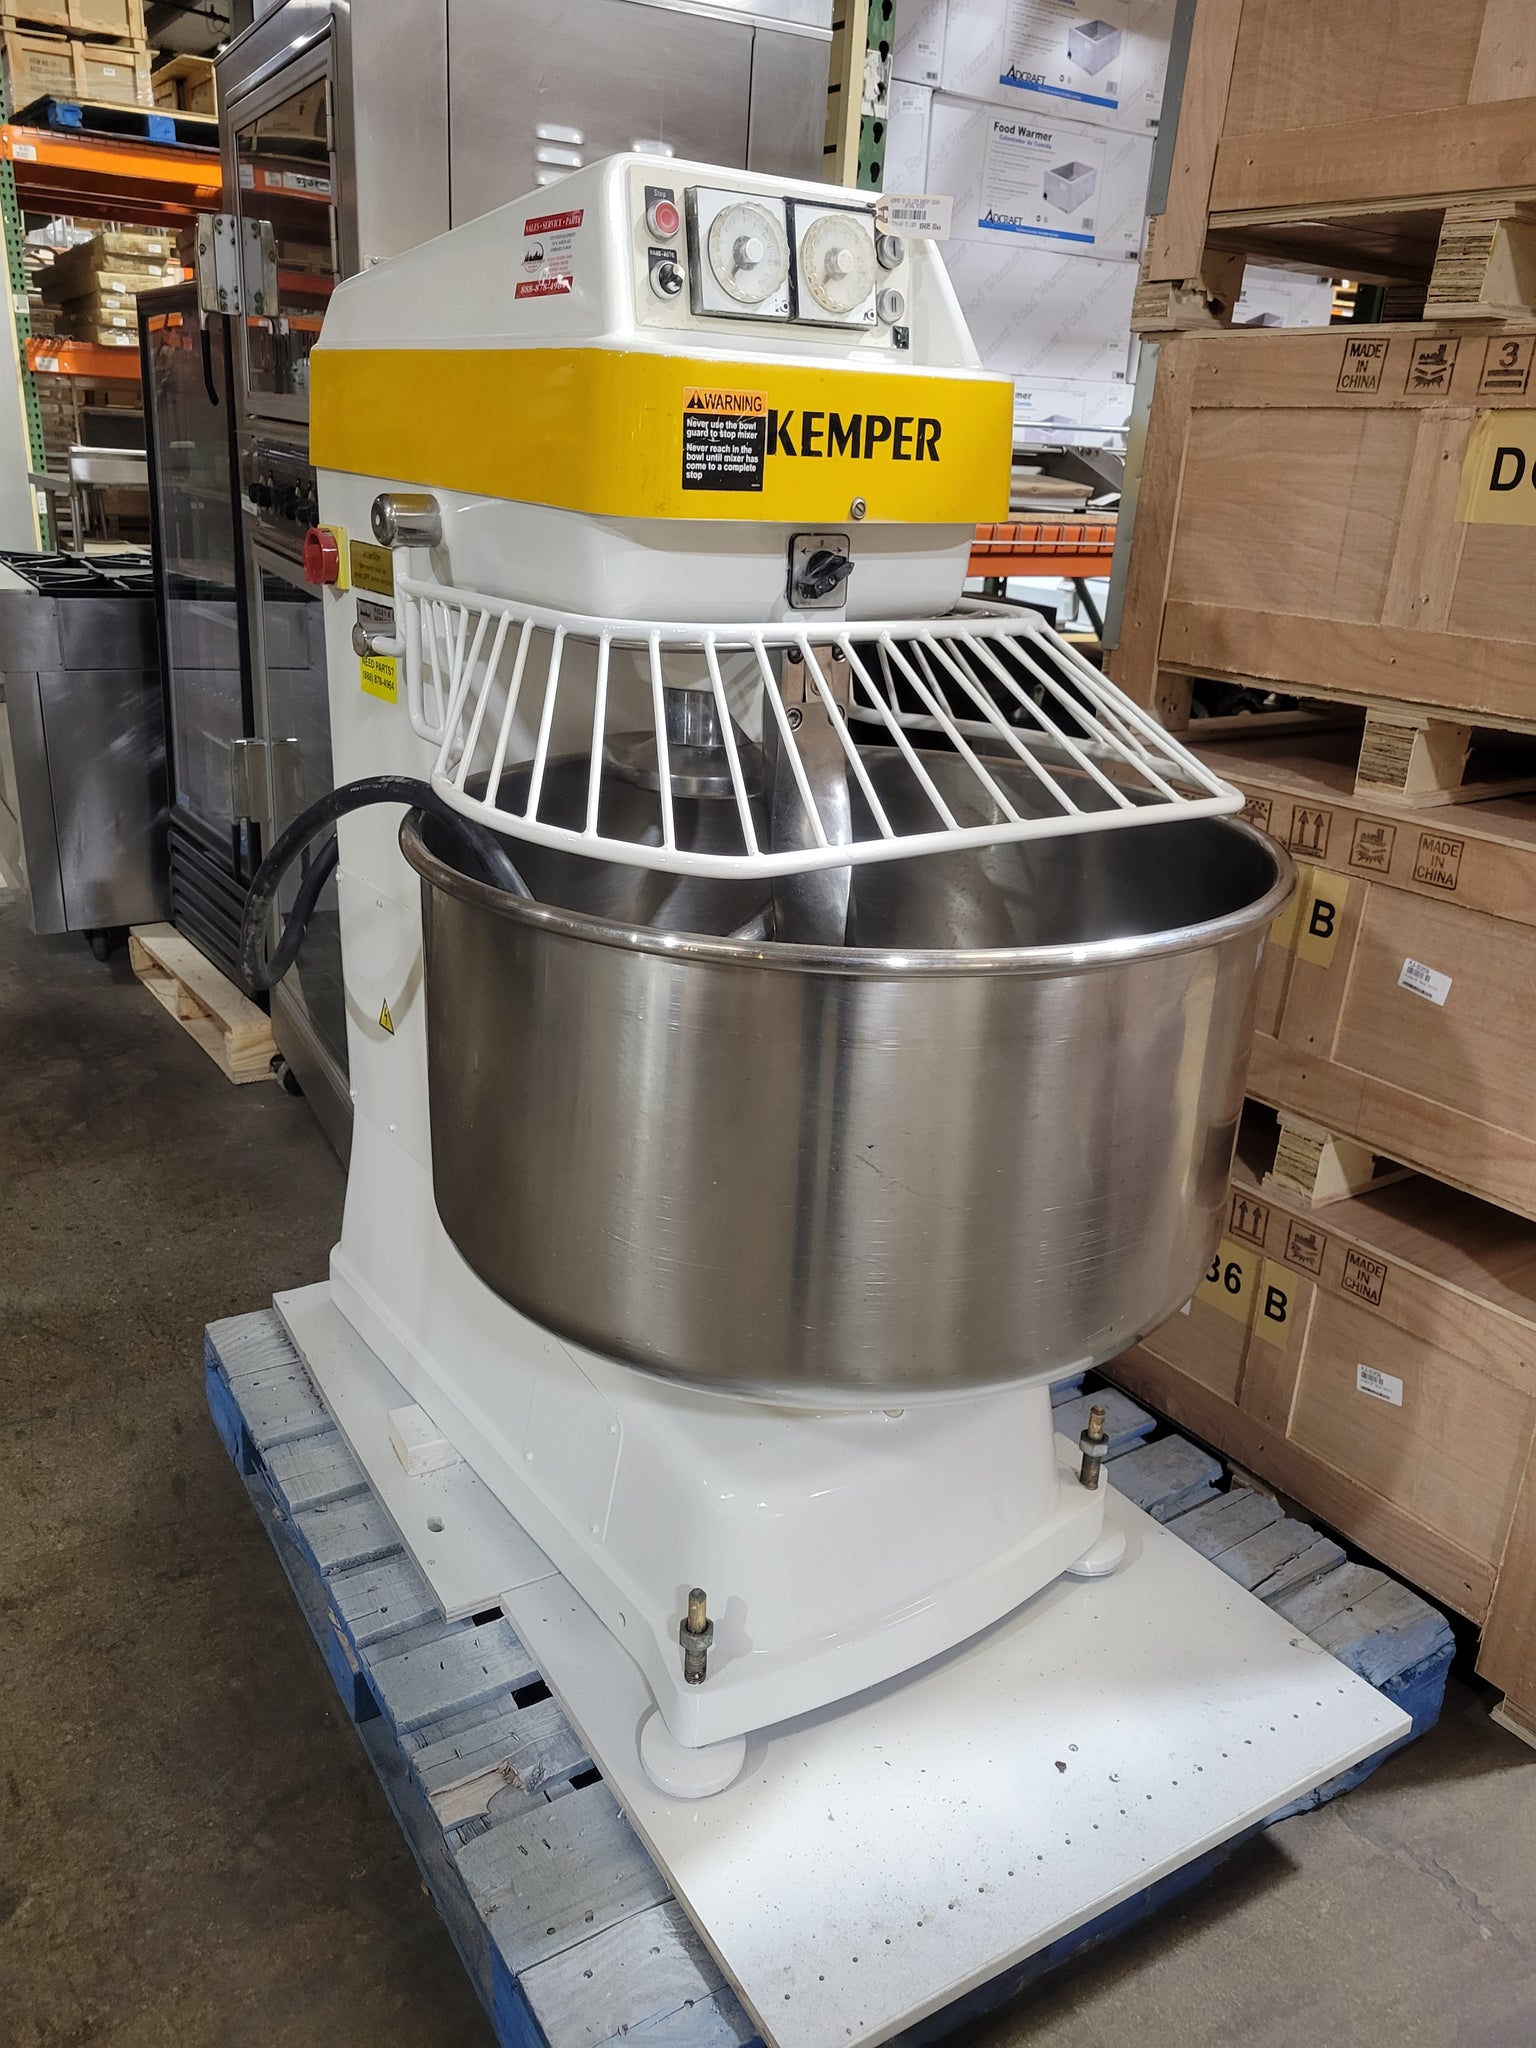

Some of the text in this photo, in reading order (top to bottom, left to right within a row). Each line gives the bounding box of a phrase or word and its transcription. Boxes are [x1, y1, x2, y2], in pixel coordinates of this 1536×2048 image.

[1006, 63, 1047, 85] ADCRAFT
[993, 121, 1052, 141] Food Warmer
[653, 189, 667, 199] Stop
[984, 208, 1024, 226] ADCRAFT
[1349, 343, 1384, 358] MADE
[1498, 341, 1520, 368] 3
[1355, 359, 1369, 373] IN
[1341, 374, 1376, 388] CHINA
[704, 393, 762, 412] WARNING
[1015, 392, 1032, 400] mer
[686, 418, 757, 430] Never use the bowl
[686, 428, 758, 440] guard to stop mixer
[766, 408, 942, 462] KEMPER
[686, 443, 753, 454] Never reach in the
[686, 452, 759, 463] bowl until mixer has
[685, 462, 757, 473] come to a complete
[685, 470, 703, 480] stop
[1489, 447, 1536, 491] D
[362, 656, 395, 677] NEED PARTS?
[362, 670, 395, 691] (888) 878-4964
[1422, 837, 1460, 858] MADE
[1430, 855, 1446, 869] IN
[1416, 865, 1454, 886] CHINA
[1309, 898, 1336, 939] B
[1350, 1253, 1384, 1278] MADE
[1357, 1270, 1370, 1285] IN
[1345, 1276, 1377, 1302] CHINA
[1264, 1285, 1288, 1323] B
